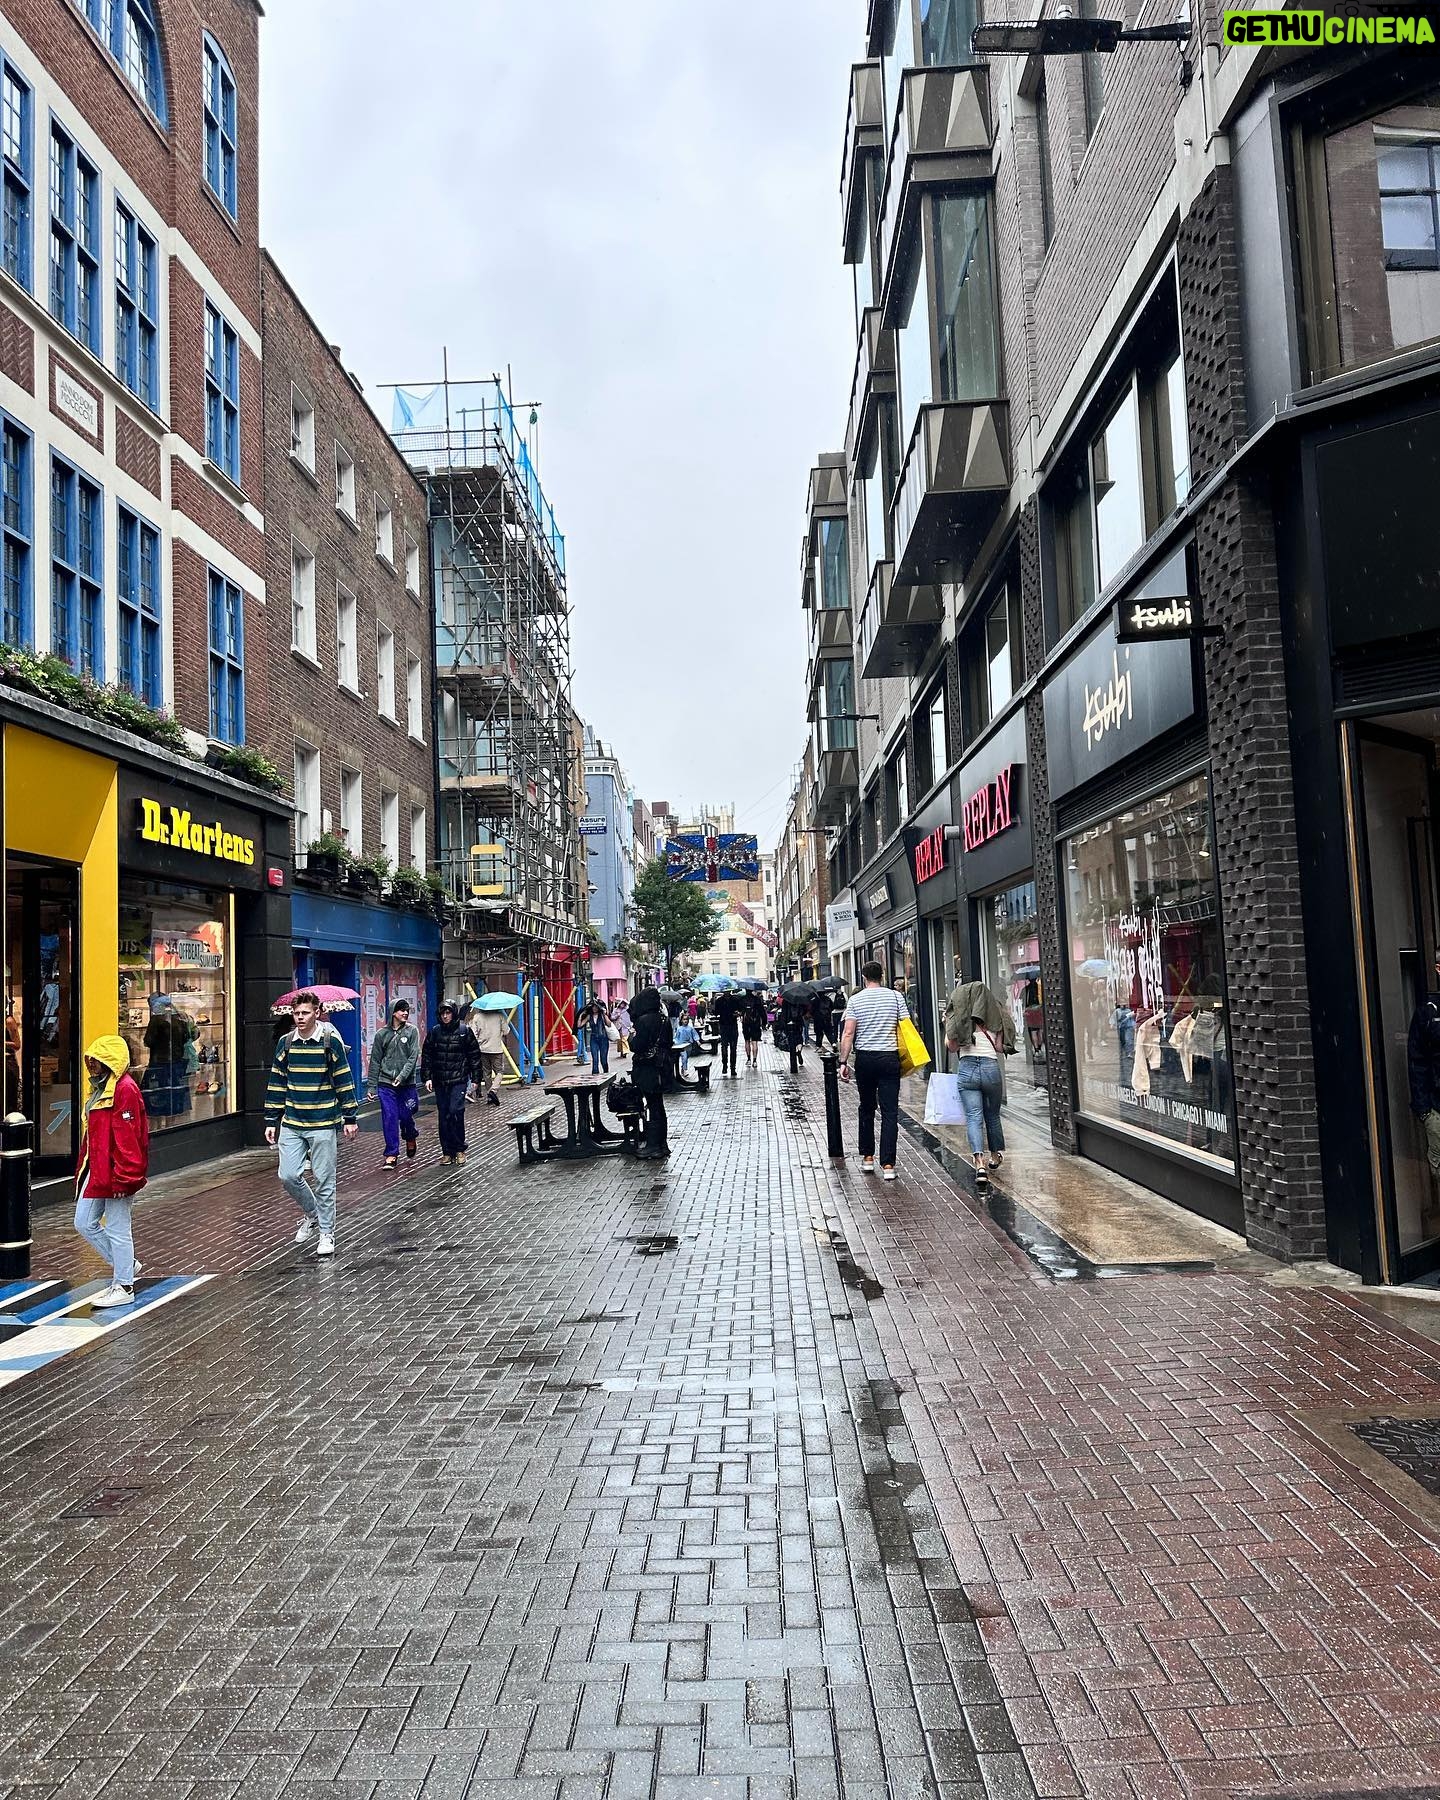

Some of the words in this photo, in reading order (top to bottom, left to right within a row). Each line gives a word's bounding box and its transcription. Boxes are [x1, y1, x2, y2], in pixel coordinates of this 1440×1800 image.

[1131, 600, 1192, 629] ksubi
[1083, 647, 1133, 751] ksubi
[963, 764, 1012, 854] REPLAY
[170, 806, 255, 865] Martens
[915, 824, 944, 885] REPLAY
[179, 941, 200, 960] OFFBEAT
[200, 953, 222, 968] SUMMER
[1143, 1094, 1166, 1115] LONDON
[1172, 1101, 1199, 1126] CHICAGO
[1204, 1109, 1228, 1134] MIAMI
